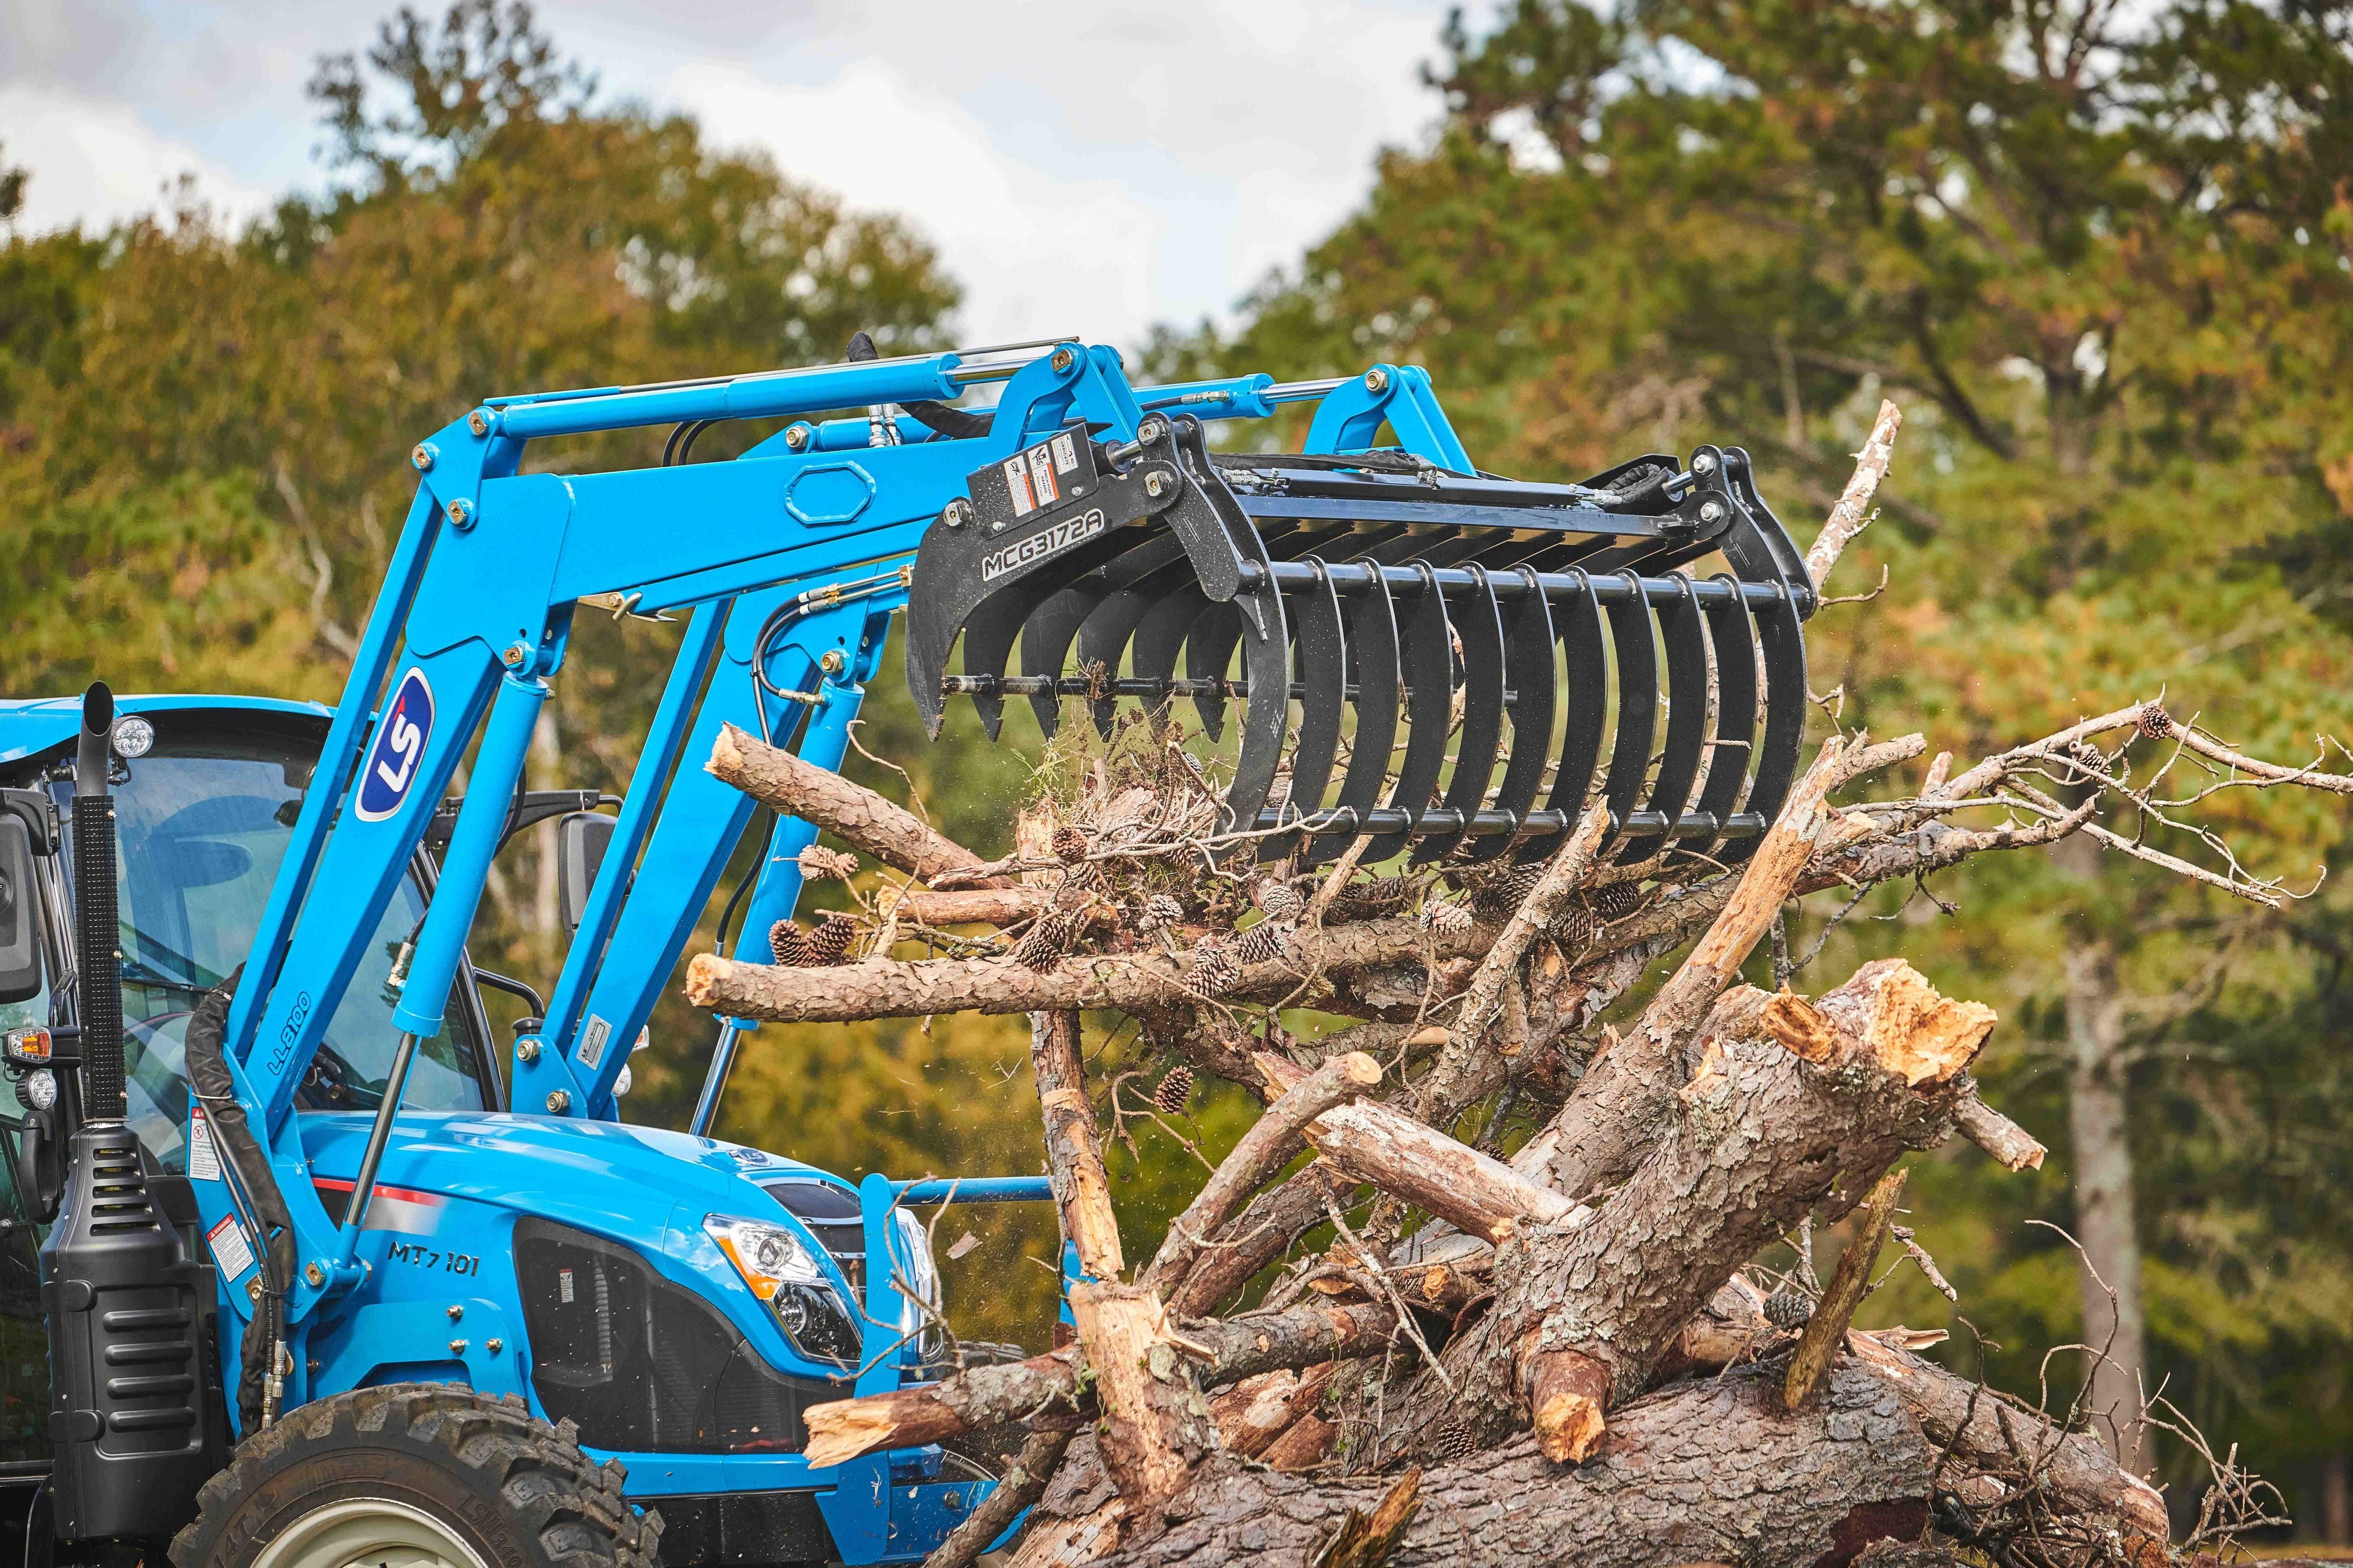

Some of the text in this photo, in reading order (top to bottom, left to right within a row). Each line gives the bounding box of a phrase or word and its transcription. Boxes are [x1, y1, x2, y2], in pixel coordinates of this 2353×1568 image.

[1059, 437, 1069, 465] LUBRICATE
[984, 510, 1102, 579] MCG3172A
[377, 713, 421, 793] LS
[267, 991, 311, 1076] LL8100
[582, 1047, 587, 1058] LS
[744, 1152, 762, 1161] LS
[213, 1218, 231, 1233] WARNING
[387, 1241, 480, 1277] MT7 101
